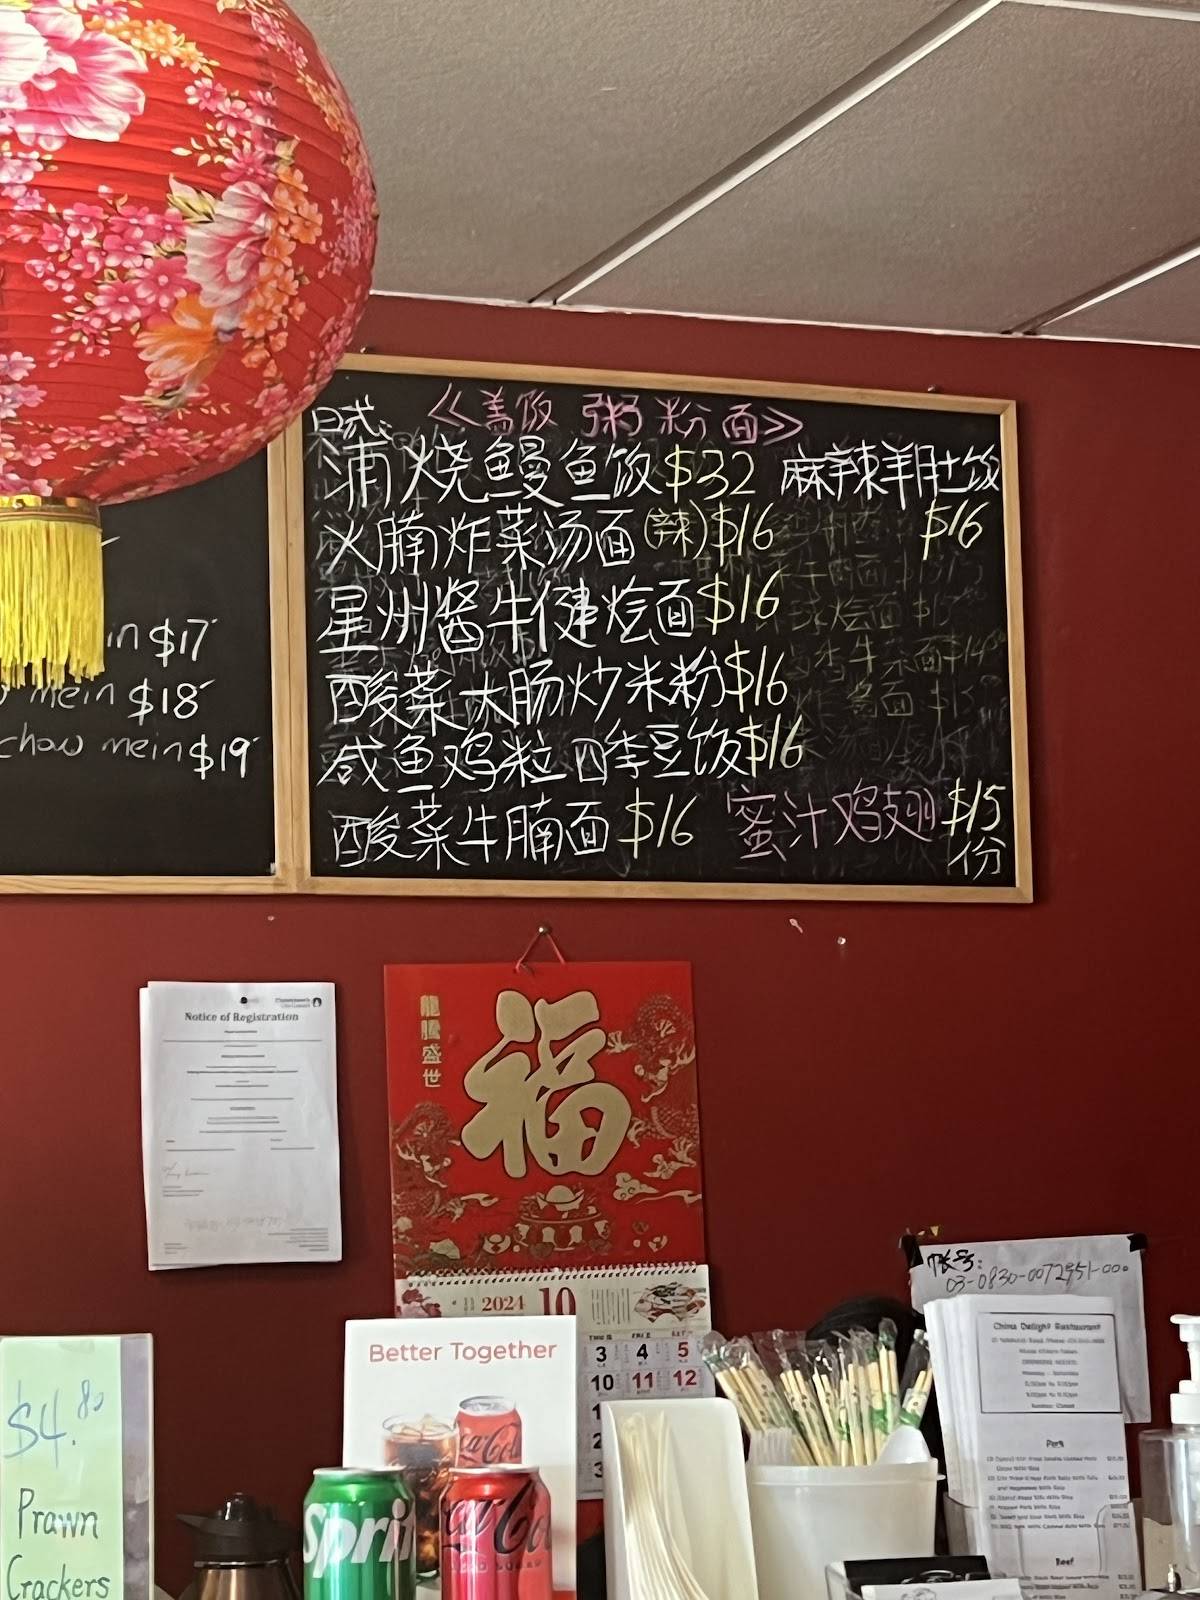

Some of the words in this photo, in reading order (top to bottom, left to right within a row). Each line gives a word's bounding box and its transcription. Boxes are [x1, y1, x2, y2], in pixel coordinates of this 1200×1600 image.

[665, 444, 756, 503] $32
[711, 502, 775, 567] $16
[920, 499, 989, 560] $16
[697, 570, 783, 635] $16
[725, 640, 788, 713] $16
[102, 733, 181, 762] mein
[736, 714, 803, 777] $16
[617, 787, 698, 859] $16
[941, 778, 1006, 836] $15
[185, 1012, 217, 1021] Notice
[220, 1012, 230, 1021] of
[233, 1012, 299, 1023] Registration
[461, 990, 632, 1178] 福
[482, 1295, 525, 1312] 2024
[539, 1287, 577, 1316] 10
[369, 1343, 442, 1363] Better
[450, 1341, 557, 1363] Together
[590, 1374, 614, 1391] 10
[632, 1372, 653, 1389] 11
[672, 1369, 697, 1387] 12
[595, 1346, 607, 1362] 3
[636, 1343, 648, 1360] 4
[678, 1342, 689, 1357] 5
[18, 1487, 98, 1539] Prawn
[7, 1554, 110, 1600] Crackers
